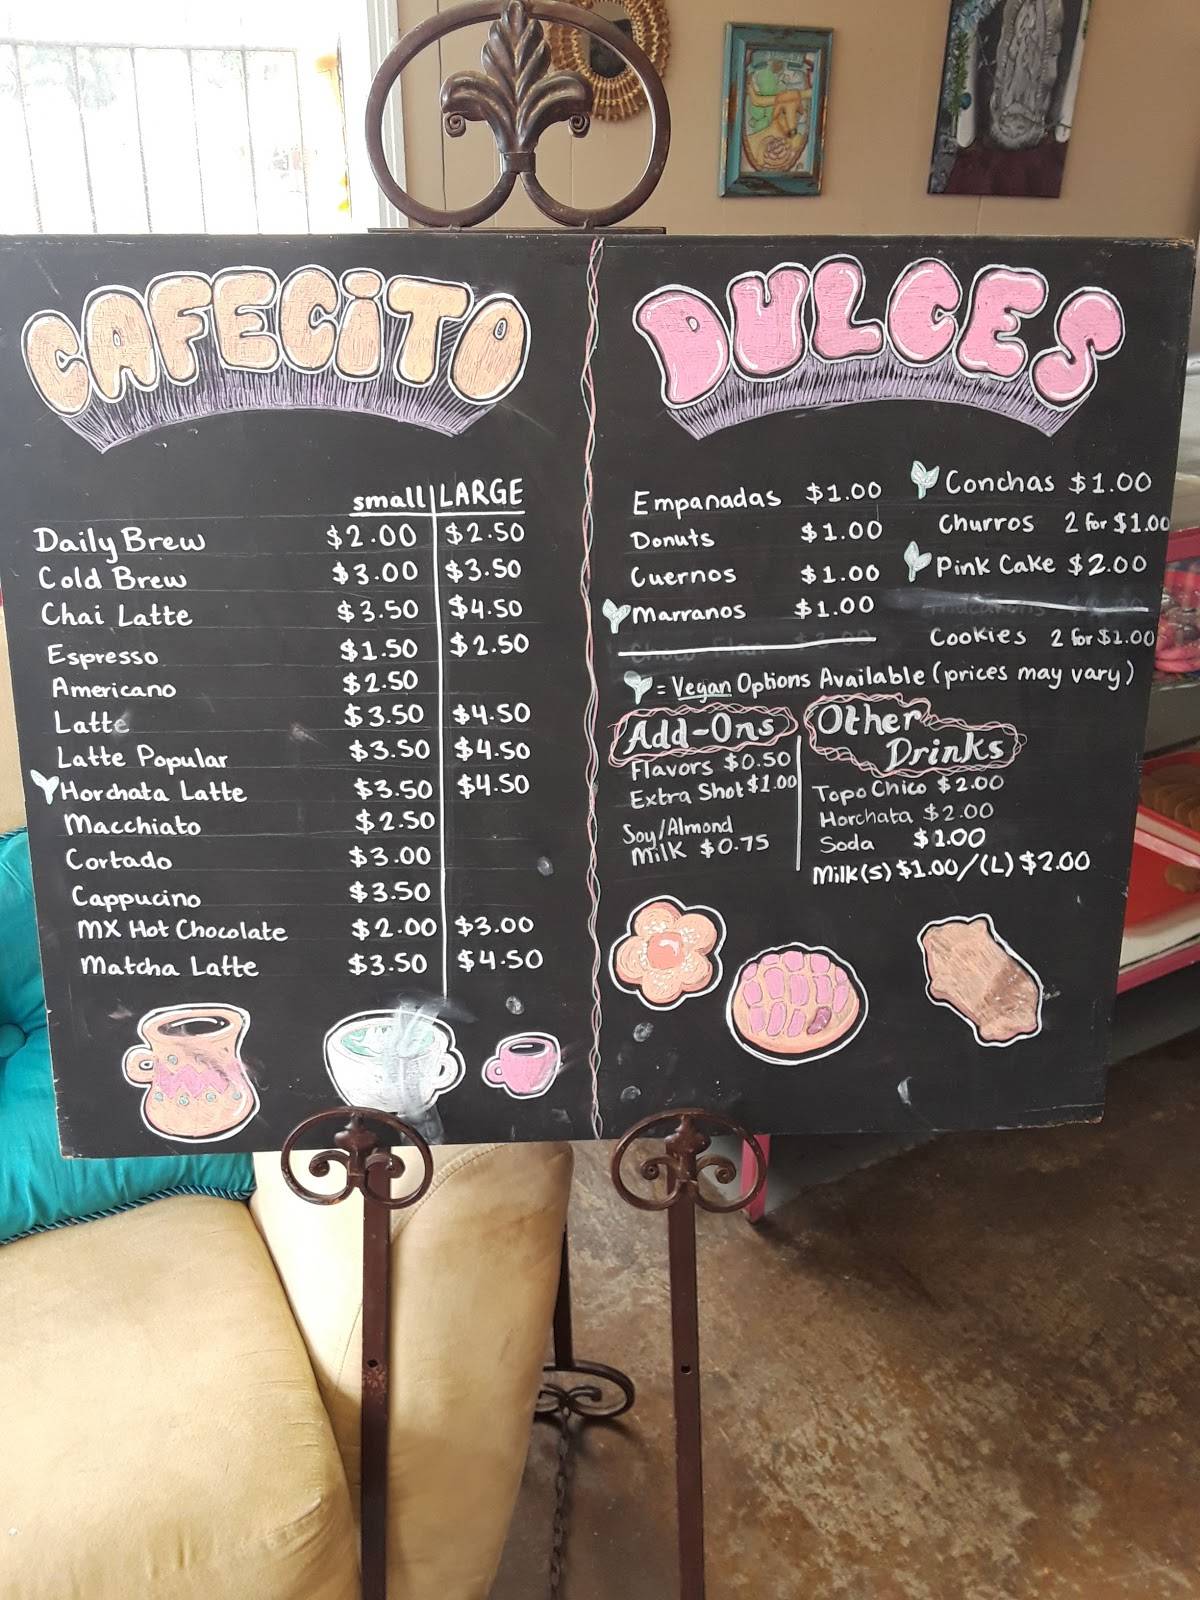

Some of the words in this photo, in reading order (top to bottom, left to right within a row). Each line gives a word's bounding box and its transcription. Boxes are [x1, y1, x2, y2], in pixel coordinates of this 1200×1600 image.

[633, 258, 1125, 408] DULCES
[439, 477, 524, 508] LARGE
[945, 469, 1055, 495] Conchas
[1068, 471, 1152, 495] $1.00
[352, 484, 427, 512] small
[632, 486, 782, 521] Empanadas
[805, 481, 882, 505] $1.00
[629, 527, 715, 550] Donuts
[800, 520, 883, 544] $1.00
[938, 513, 1035, 535] Churros
[1064, 510, 1079, 534] 2
[1084, 511, 1108, 532] for
[1113, 511, 1170, 535] $1.00
[32, 526, 119, 564] Daily
[120, 526, 206, 553] Brew
[326, 523, 417, 551] $2.00
[444, 521, 525, 546] $2.50
[38, 565, 103, 590] Cold
[111, 565, 188, 591] Brew
[331, 560, 419, 586] $3.00
[444, 557, 522, 584] $3.50
[630, 566, 737, 588] Cuernos
[800, 563, 880, 585] $1.00
[936, 555, 991, 578] Pink
[999, 553, 1057, 575] Cake
[1067, 552, 1147, 577] $2.00
[41, 601, 105, 626] Chai
[118, 603, 193, 628] Latte
[337, 599, 419, 624] $3.50
[447, 593, 523, 620] $4.50
[632, 604, 747, 625] Marranos
[793, 595, 875, 620] $1.00
[47, 643, 159, 671] Espresso
[339, 638, 419, 663] $1.50
[449, 631, 530, 658] $2.50
[929, 626, 1027, 647] Cookies
[1050, 628, 1064, 648] 2
[1070, 627, 1094, 647] for
[1096, 628, 1155, 647] $1.00
[52, 676, 177, 699] Americano
[342, 669, 419, 696] $2.50
[672, 675, 733, 703] Vegan
[736, 671, 812, 700] Options
[819, 664, 926, 690] Available
[932, 660, 1008, 691] (prices
[1017, 666, 1063, 690] may
[1071, 659, 1135, 691] vary)
[54, 709, 130, 734] Latte
[343, 702, 425, 728] $3.50
[451, 702, 531, 726] $4.50
[623, 712, 776, 754] Add-Ons
[817, 701, 922, 737] Other
[57, 745, 127, 769] Latte
[136, 743, 229, 776] Popular
[348, 738, 431, 763] $3.50
[453, 735, 531, 762] $4.50
[630, 758, 715, 783] Flavors
[723, 751, 792, 773] $0.50
[885, 733, 1004, 771] Drinks
[60, 781, 171, 803] Horchata
[179, 779, 248, 803] Latte
[353, 777, 433, 801] $3.50
[456, 772, 530, 800] $4.50
[629, 787, 693, 810] Extra
[697, 781, 745, 802] Shot
[747, 773, 797, 795] $1.00
[811, 784, 867, 807] Topo
[871, 779, 927, 798] Chico
[938, 774, 1005, 795] $2.00
[63, 812, 202, 836] Macchiato
[354, 808, 436, 836] $2.50
[621, 815, 734, 847] Soy/Almond
[819, 807, 914, 829] Horchata
[922, 802, 994, 822] $2.00
[631, 839, 688, 867] Milk
[699, 833, 770, 859] $0.75
[819, 832, 875, 854] Soda
[912, 826, 986, 850] $1.00
[65, 847, 173, 871] Cortado
[348, 845, 432, 869] $3.00
[1018, 850, 1091, 876] $2.00
[71, 884, 202, 913] Cappucino
[348, 880, 431, 904] $3.50
[77, 918, 122, 940] MX
[128, 919, 170, 939] Hot
[175, 918, 289, 942] Chocolate
[351, 917, 438, 942] $2.00
[454, 914, 535, 938] $3.00
[80, 954, 181, 977] Matcha
[190, 954, 260, 978] Latte
[347, 952, 428, 977] $3.50
[456, 948, 544, 973] $4.50
